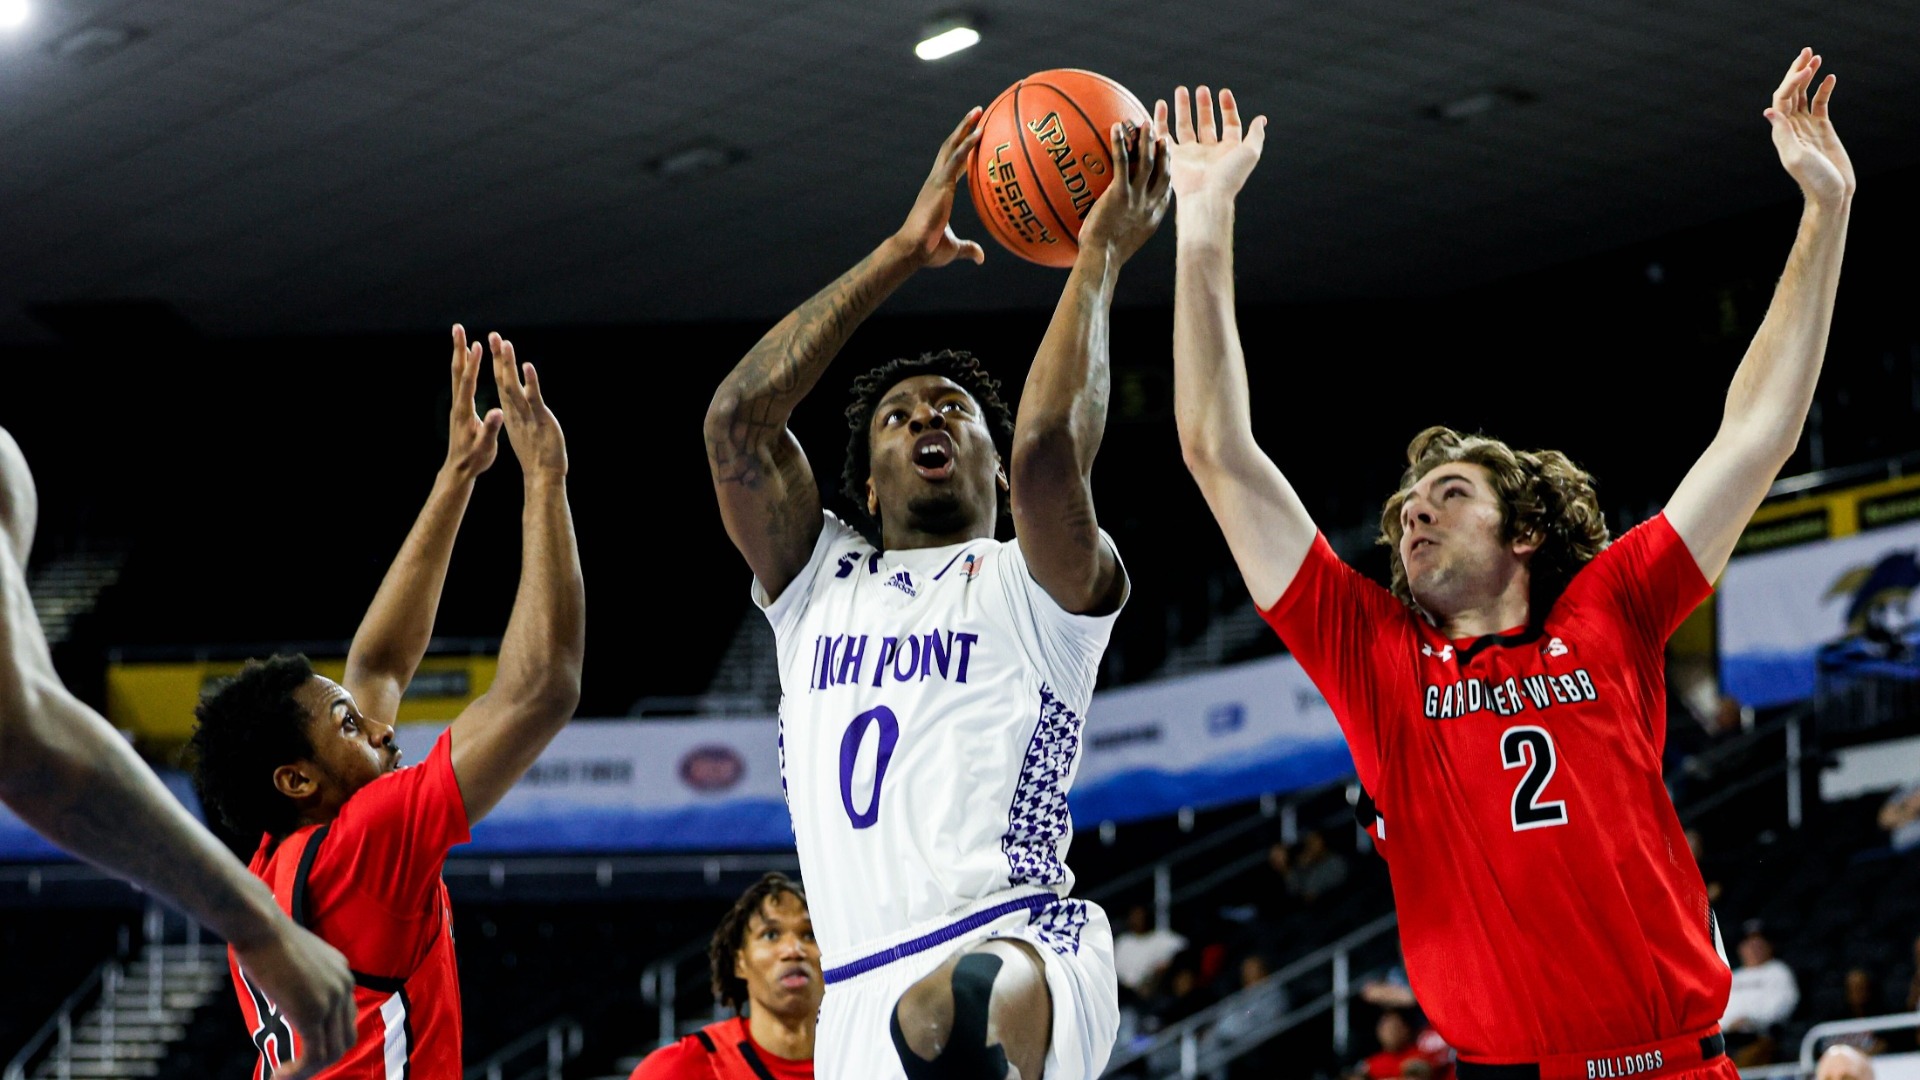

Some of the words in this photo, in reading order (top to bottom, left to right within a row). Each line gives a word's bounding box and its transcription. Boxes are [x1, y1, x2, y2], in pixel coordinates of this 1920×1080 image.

[994, 141, 1059, 245] LEGACY
[1026, 111, 1097, 220] SPALDIN
[883, 574, 917, 598] adidas
[872, 627, 979, 688] POINT
[839, 705, 899, 830] 0
[1500, 725, 1568, 832] 2
[1586, 1049, 1664, 1080] BULLDOGS
